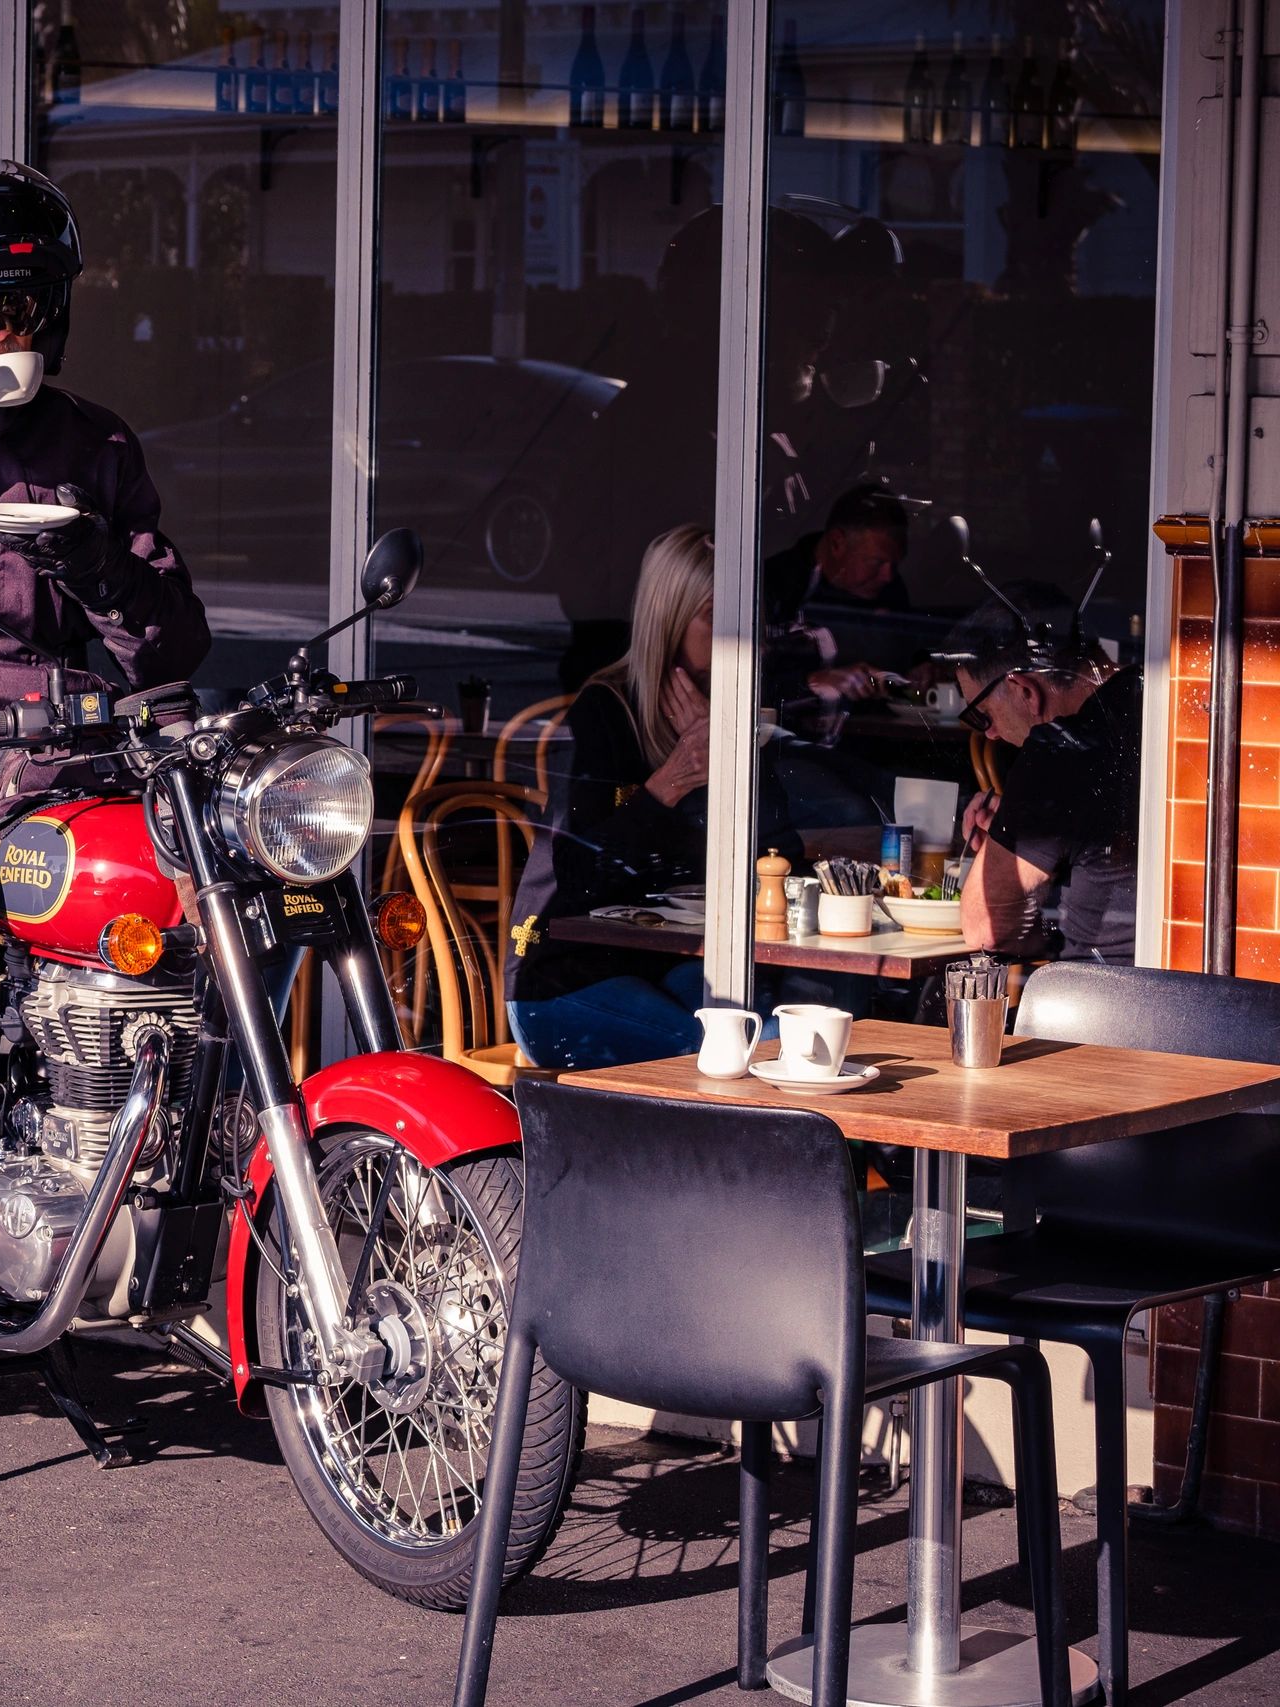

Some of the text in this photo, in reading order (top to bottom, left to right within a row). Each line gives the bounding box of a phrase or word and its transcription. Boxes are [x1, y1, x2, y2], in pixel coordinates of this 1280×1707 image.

[4, 844, 47, 867] ROYAL
[0, 866, 52, 889] ENFIELD
[283, 894, 318, 905] ROYAL
[283, 903, 324, 917] ENFIELD
